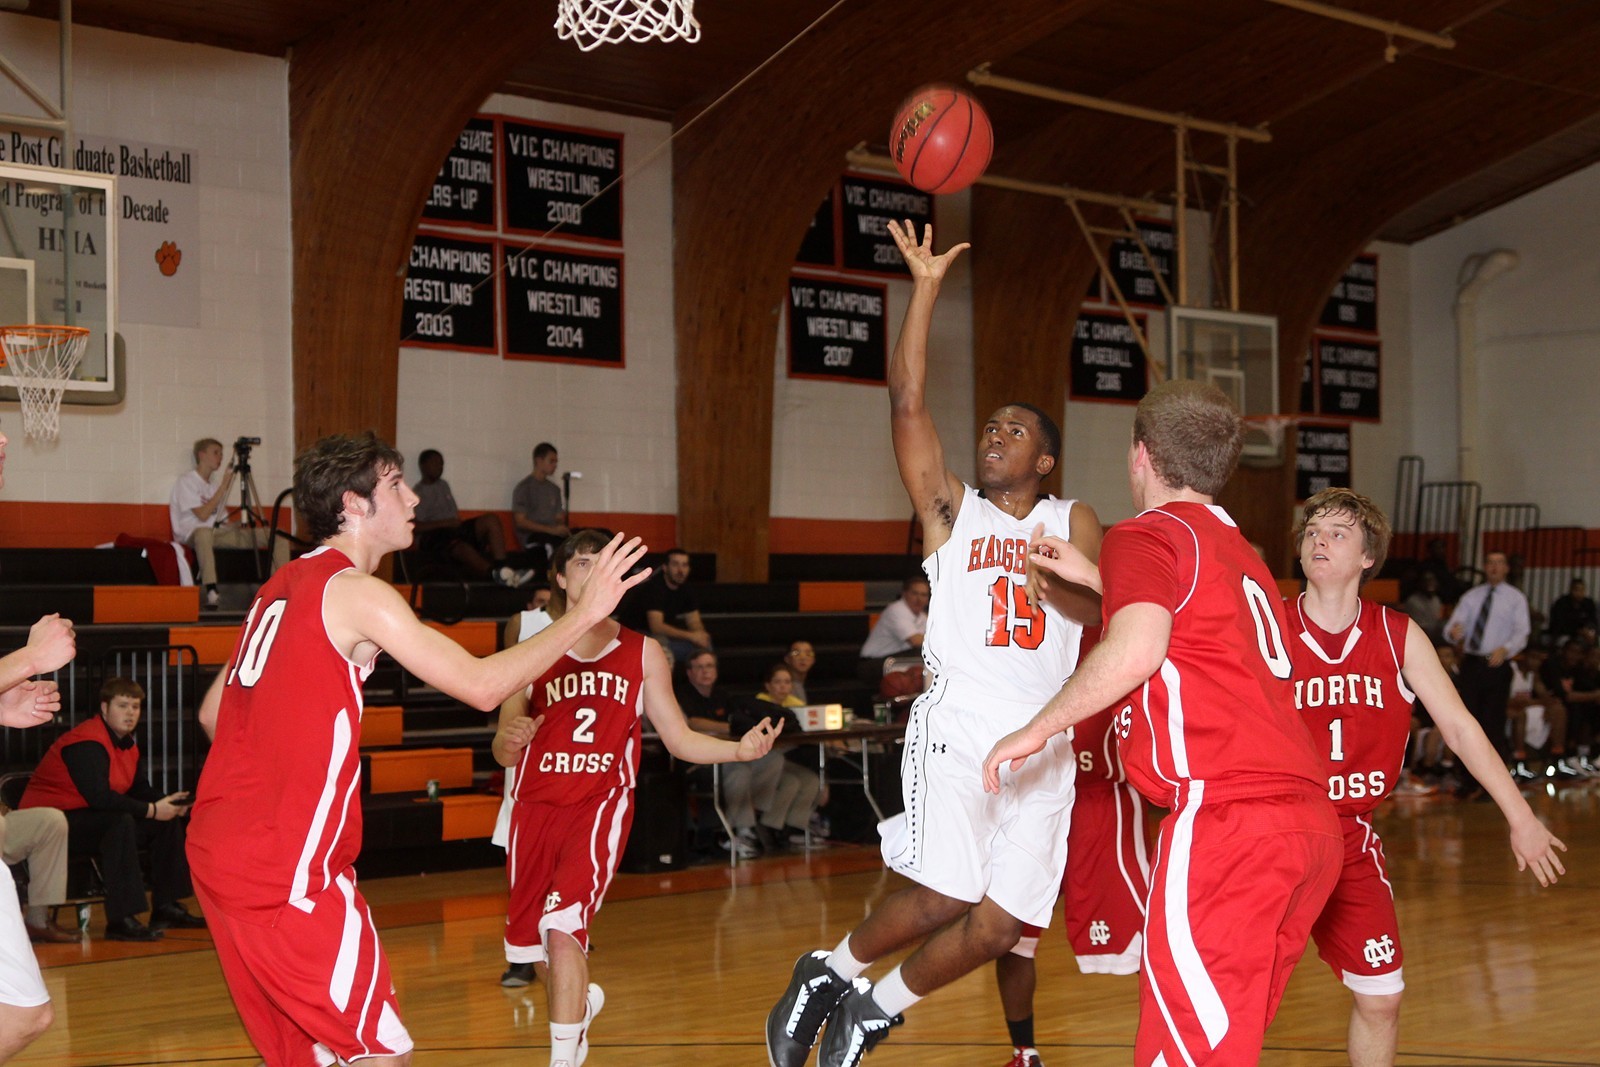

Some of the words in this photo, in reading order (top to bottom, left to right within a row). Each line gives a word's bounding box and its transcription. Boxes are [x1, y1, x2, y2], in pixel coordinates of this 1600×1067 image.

[460, 129, 493, 154] STATE
[508, 132, 538, 159] VIC
[542, 138, 615, 169] CHAMPIONS
[11, 131, 42, 166] Post
[47, 136, 115, 175] Grduate
[119, 145, 191, 184] Basketball
[426, 184, 478, 209] RS-UP
[527, 166, 600, 197] WRESTLING
[15, 182, 64, 217] Progra
[79, 192, 93, 216] of
[123, 195, 169, 224] Decade
[547, 201, 582, 225] 2000
[844, 184, 866, 206] VIC
[869, 188, 929, 215] CHAMPIONS
[409, 245, 492, 275] CHAMPIONS
[507, 254, 538, 280] VIC
[543, 259, 618, 289] CHAMPIONS
[404, 278, 473, 307] RESTLING
[527, 290, 601, 319] WRESTLING
[791, 285, 815, 308] VIC
[819, 289, 882, 316] CHAMPIONS
[415, 313, 454, 337] 2003
[546, 325, 584, 348] 2004
[806, 316, 870, 342] WRESTLING
[1075, 320, 1090, 339] IC
[1092, 321, 1143, 344] CHAMPIO
[823, 346, 853, 367] 2007
[1082, 344, 1133, 368] BASEBALL
[985, 575, 1046, 650] 15
[1241, 573, 1293, 680] 0
[226, 597, 288, 687] 10
[545, 671, 629, 707] NORTH
[1294, 673, 1384, 710] NORTH
[572, 707, 597, 743] 2
[1328, 718, 1344, 761] 1
[539, 752, 614, 773] CROSS
[1327, 770, 1386, 801] OSS
